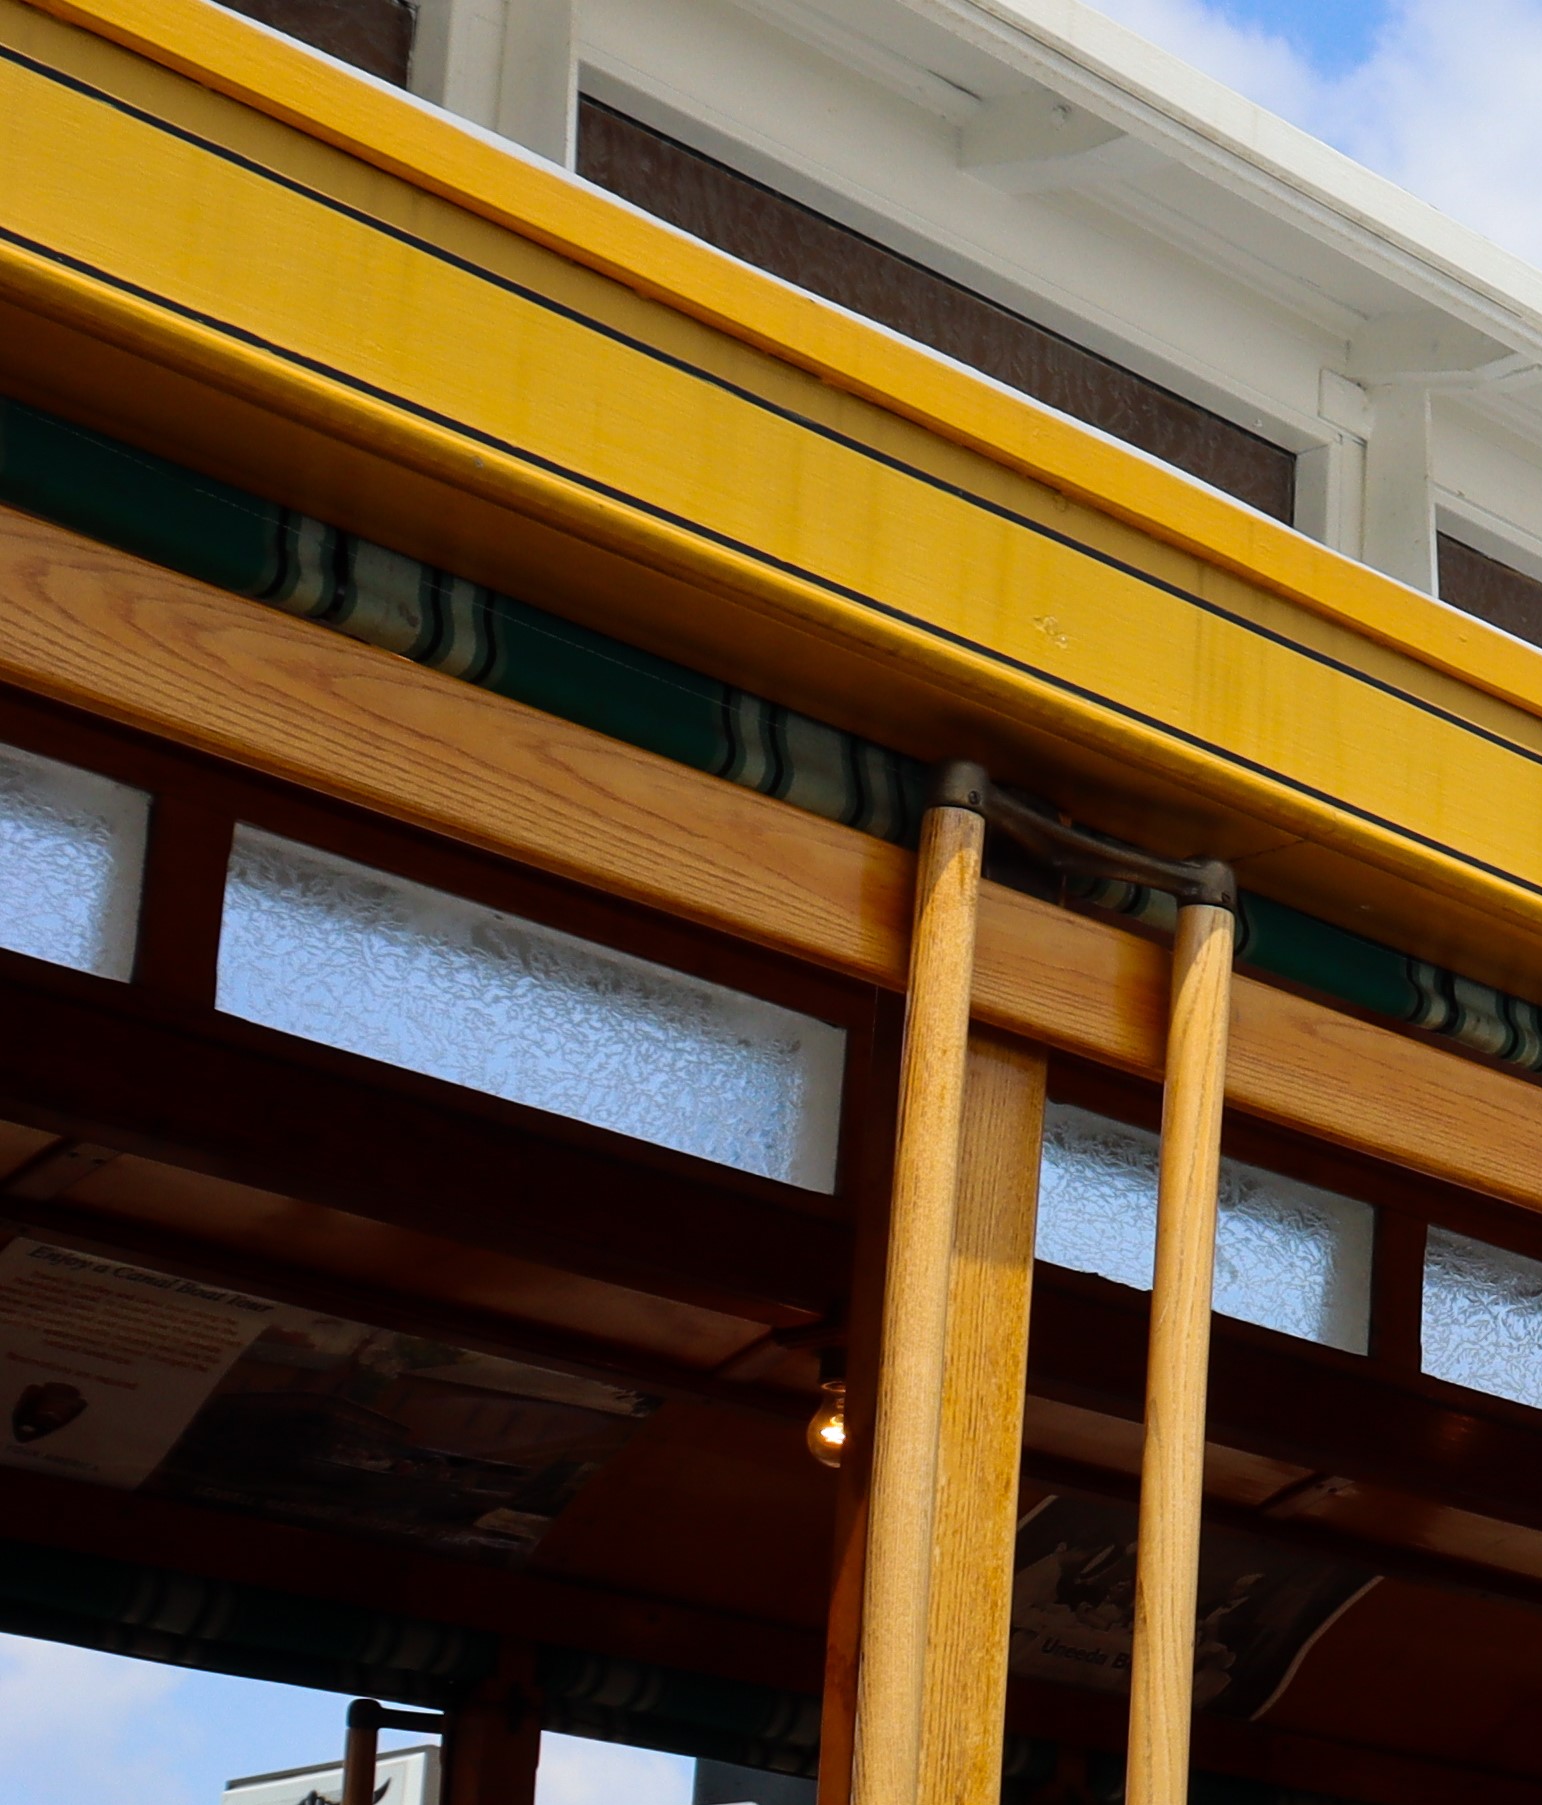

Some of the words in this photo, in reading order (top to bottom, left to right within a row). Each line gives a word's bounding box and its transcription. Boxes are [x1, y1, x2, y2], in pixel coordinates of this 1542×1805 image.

[27, 1245, 93, 1271] Enjoy
[92, 1263, 109, 1274] a
[112, 1266, 179, 1291] Canal
[175, 1280, 228, 1302] Boat
[227, 1293, 275, 1313] Tour
[1040, 1636, 1109, 1666] Uneeda
